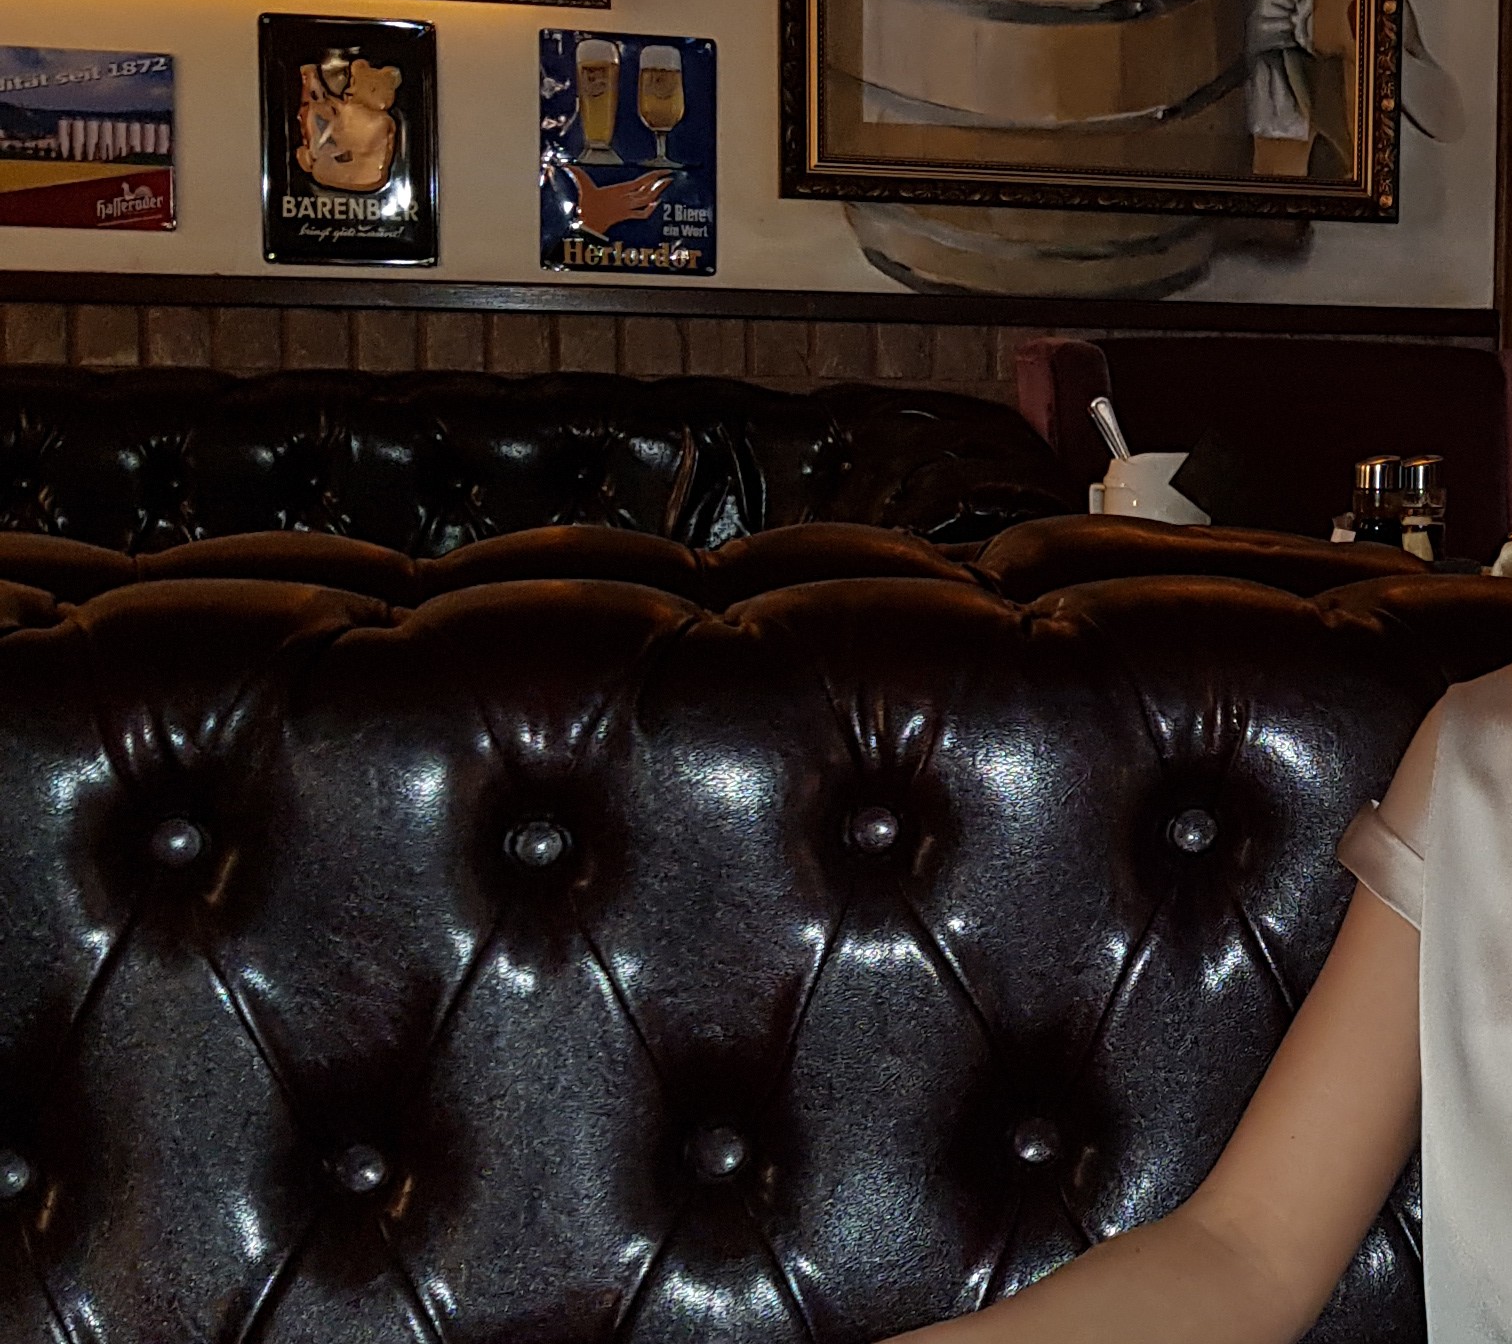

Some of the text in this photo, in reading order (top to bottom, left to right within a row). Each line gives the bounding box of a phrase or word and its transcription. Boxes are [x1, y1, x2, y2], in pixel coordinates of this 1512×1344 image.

[55, 66, 101, 86] seit
[107, 57, 169, 77] 1872
[662, 203, 672, 221] 2
[680, 224, 709, 238] Wort
